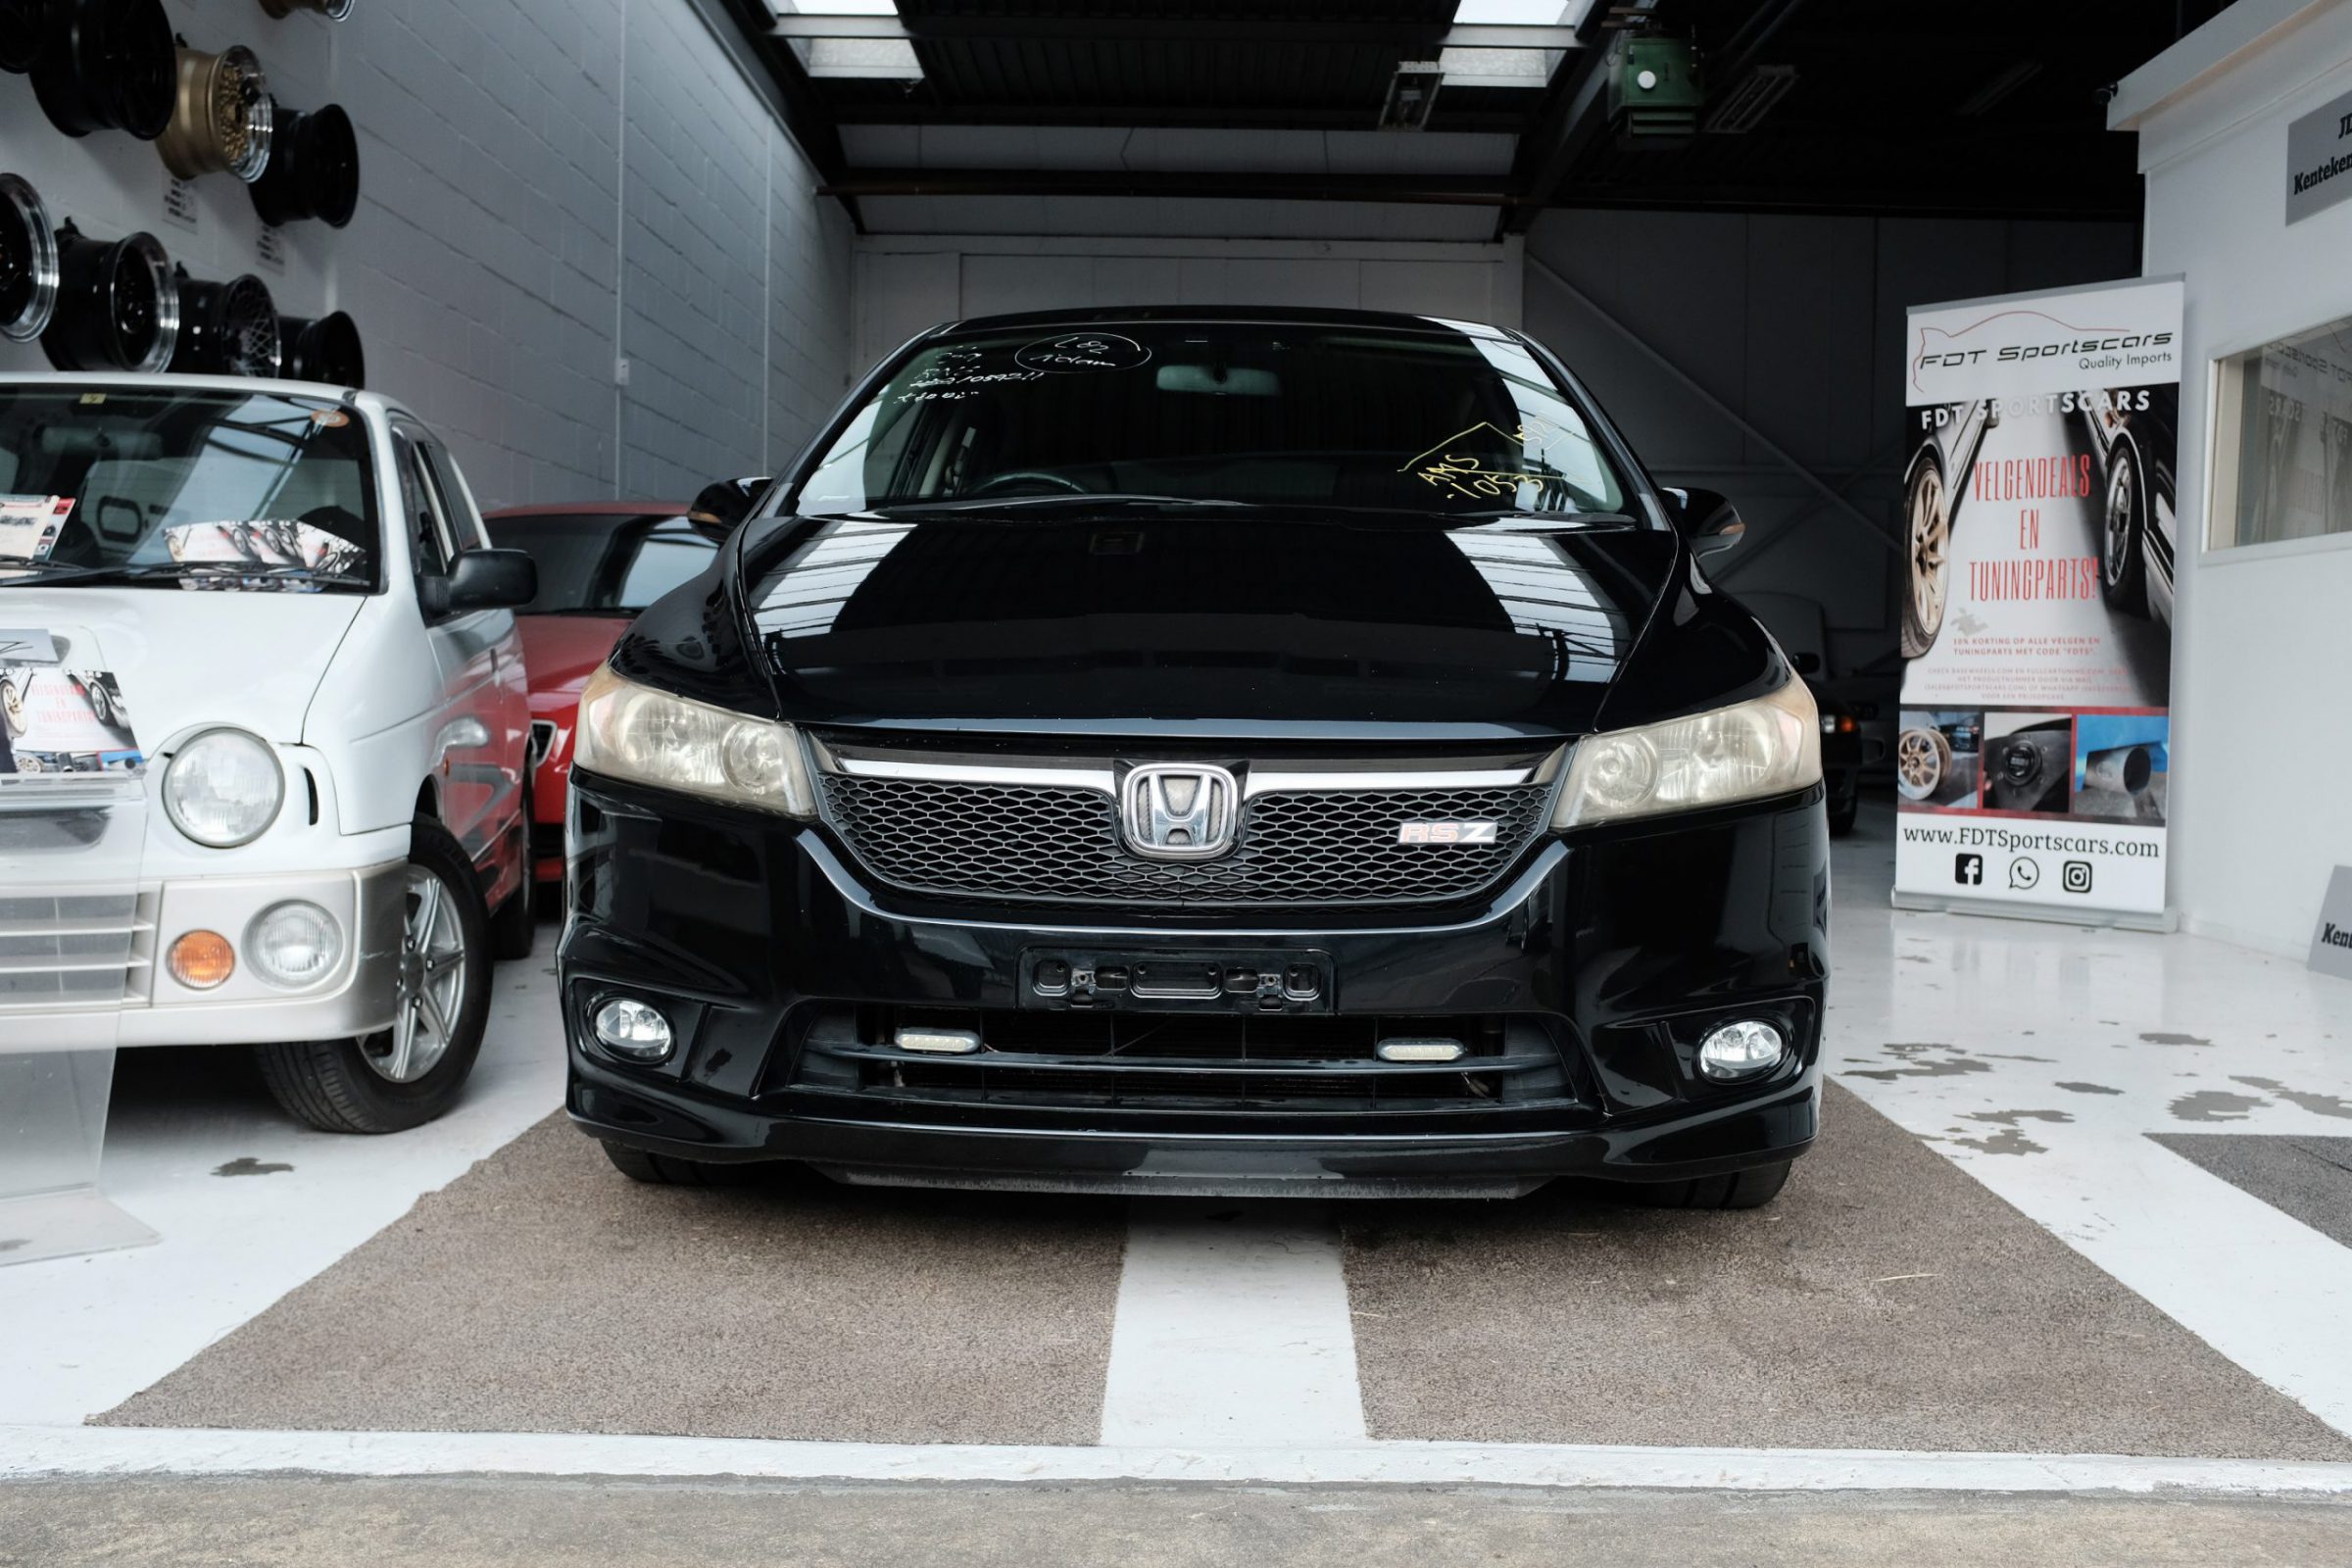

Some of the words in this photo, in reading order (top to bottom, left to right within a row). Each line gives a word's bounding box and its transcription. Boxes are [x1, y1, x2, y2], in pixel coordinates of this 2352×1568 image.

[1920, 349, 1987, 369] FDT
[1997, 332, 2174, 363] Sportscars
[2078, 357, 2122, 370] Quality
[2126, 351, 2173, 368] Imports
[1921, 405, 1963, 430] FDT
[1975, 390, 2151, 421] SPORTSCARS
[1975, 454, 2090, 502] VELGENDEALS
[2019, 509, 2039, 550] EN
[1969, 557, 2098, 602] TUNINGPARTS!
[1400, 822, 1496, 844] RSZ
[1903, 826, 2160, 858] www.FDTSportscars.com
